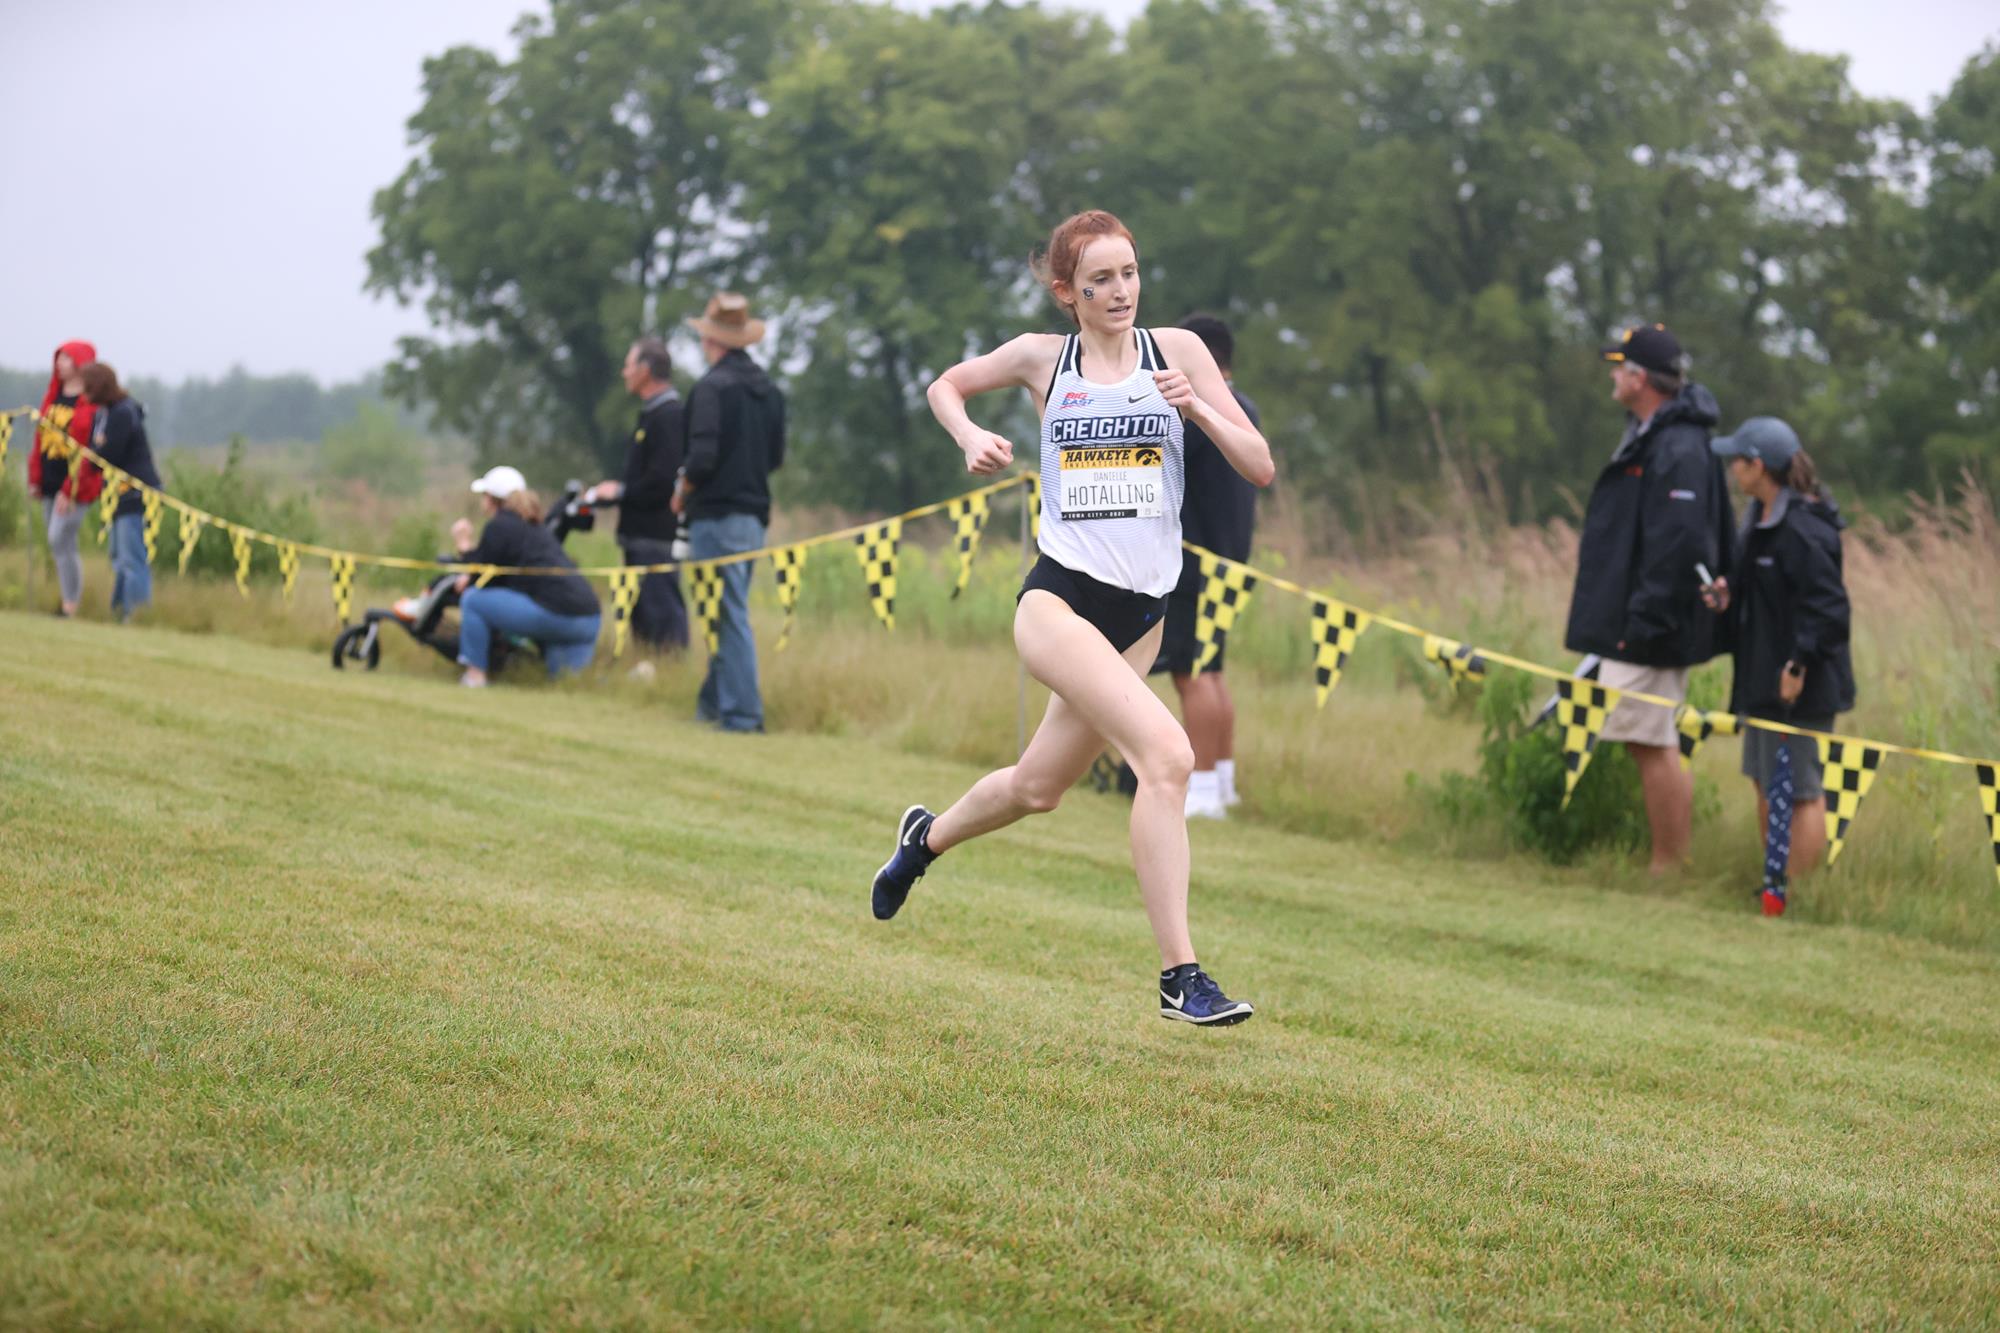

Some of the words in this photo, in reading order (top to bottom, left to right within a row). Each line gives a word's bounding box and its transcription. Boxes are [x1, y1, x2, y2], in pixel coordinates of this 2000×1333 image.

[1051, 414, 1170, 442] CREIGHTON
[1065, 449, 1131, 463] HAWKEYE
[1064, 459, 1130, 469] INVITATIONAL
[1093, 471, 1128, 482] DANIELLE
[1068, 483, 1155, 507] HOTALLING
